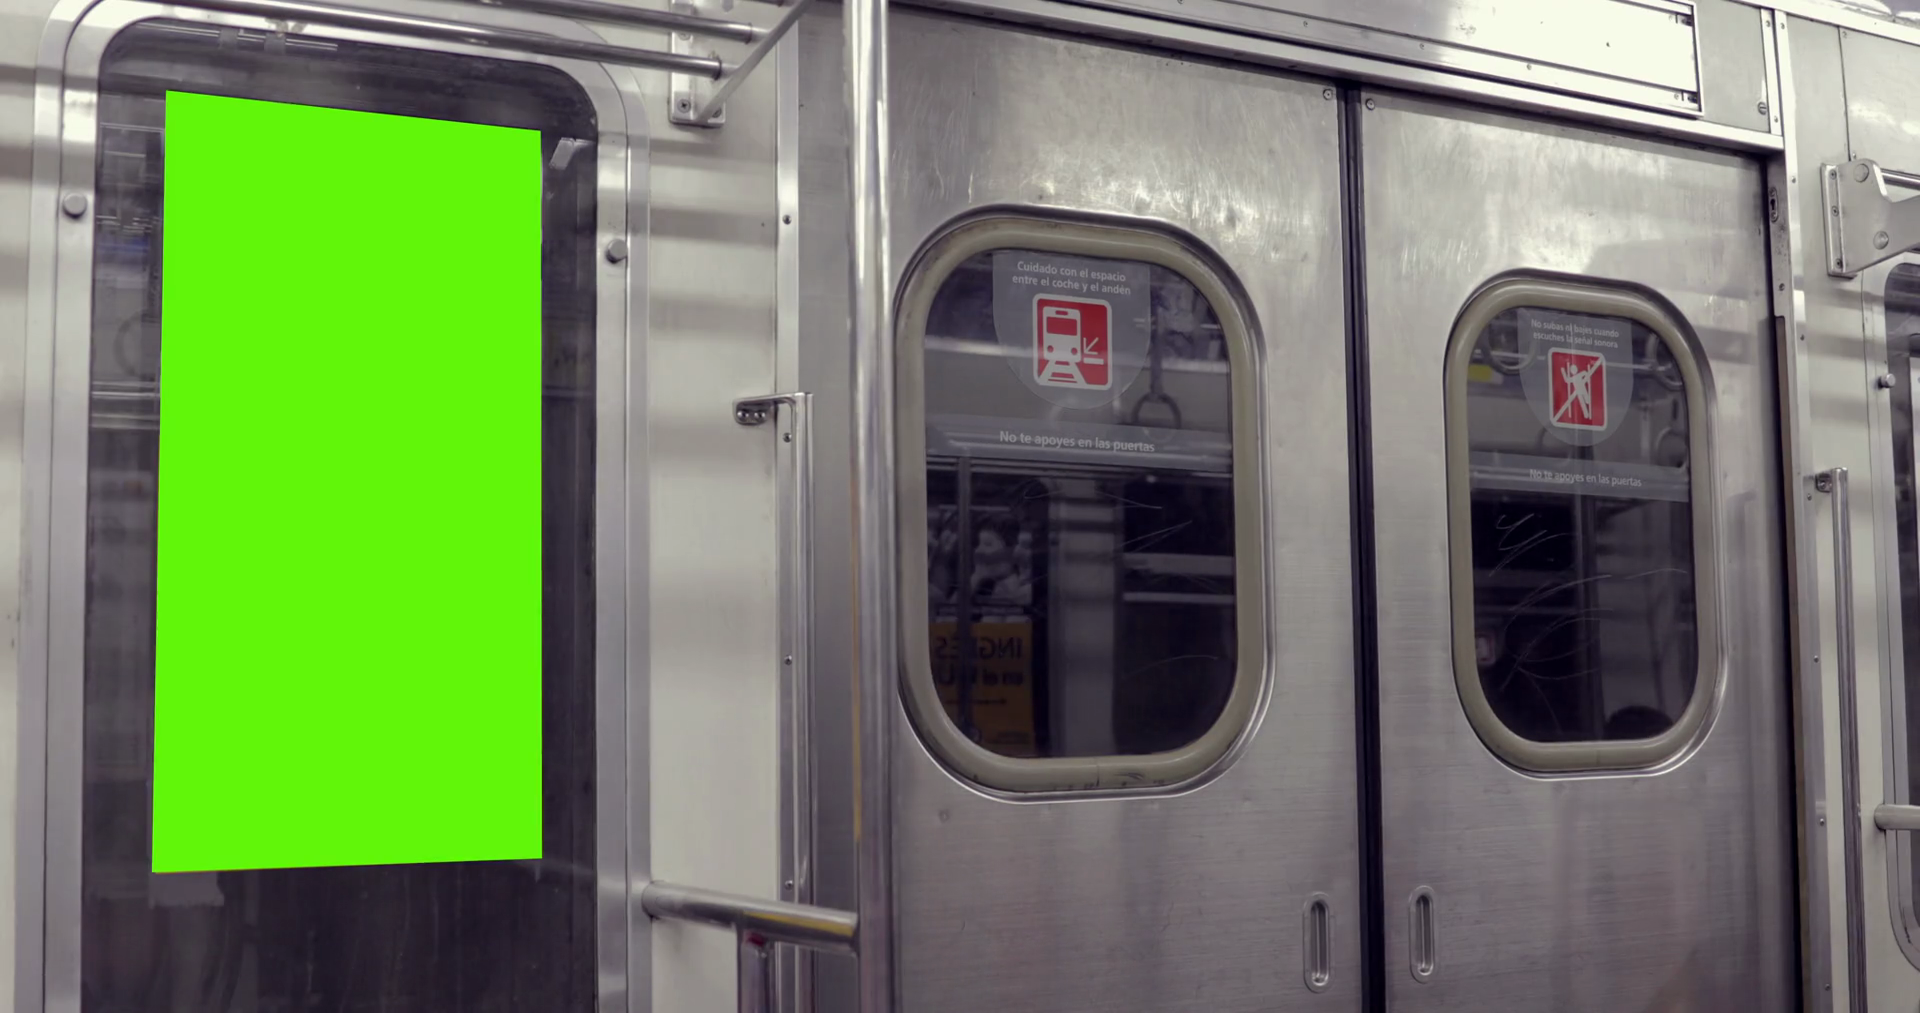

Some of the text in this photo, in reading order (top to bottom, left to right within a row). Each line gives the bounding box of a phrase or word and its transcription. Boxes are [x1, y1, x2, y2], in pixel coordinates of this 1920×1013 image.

[1017, 261, 1126, 282] Cuidado con el espacio
[1012, 275, 1038, 285] entre
[1040, 276, 1050, 287] el
[1052, 278, 1080, 290] coche
[1082, 284, 1088, 293] y
[1090, 283, 1099, 292] el
[1531, 319, 1542, 328] No
[1543, 321, 1564, 331] subas
[1574, 324, 1593, 336] bajes
[1594, 329, 1619, 338] cuando
[1533, 331, 1618, 348] escuches la señal sonora
[1000, 431, 1155, 453] No te apoyes en las puertas
[1530, 469, 1642, 487] No te apoyes en las puertas
